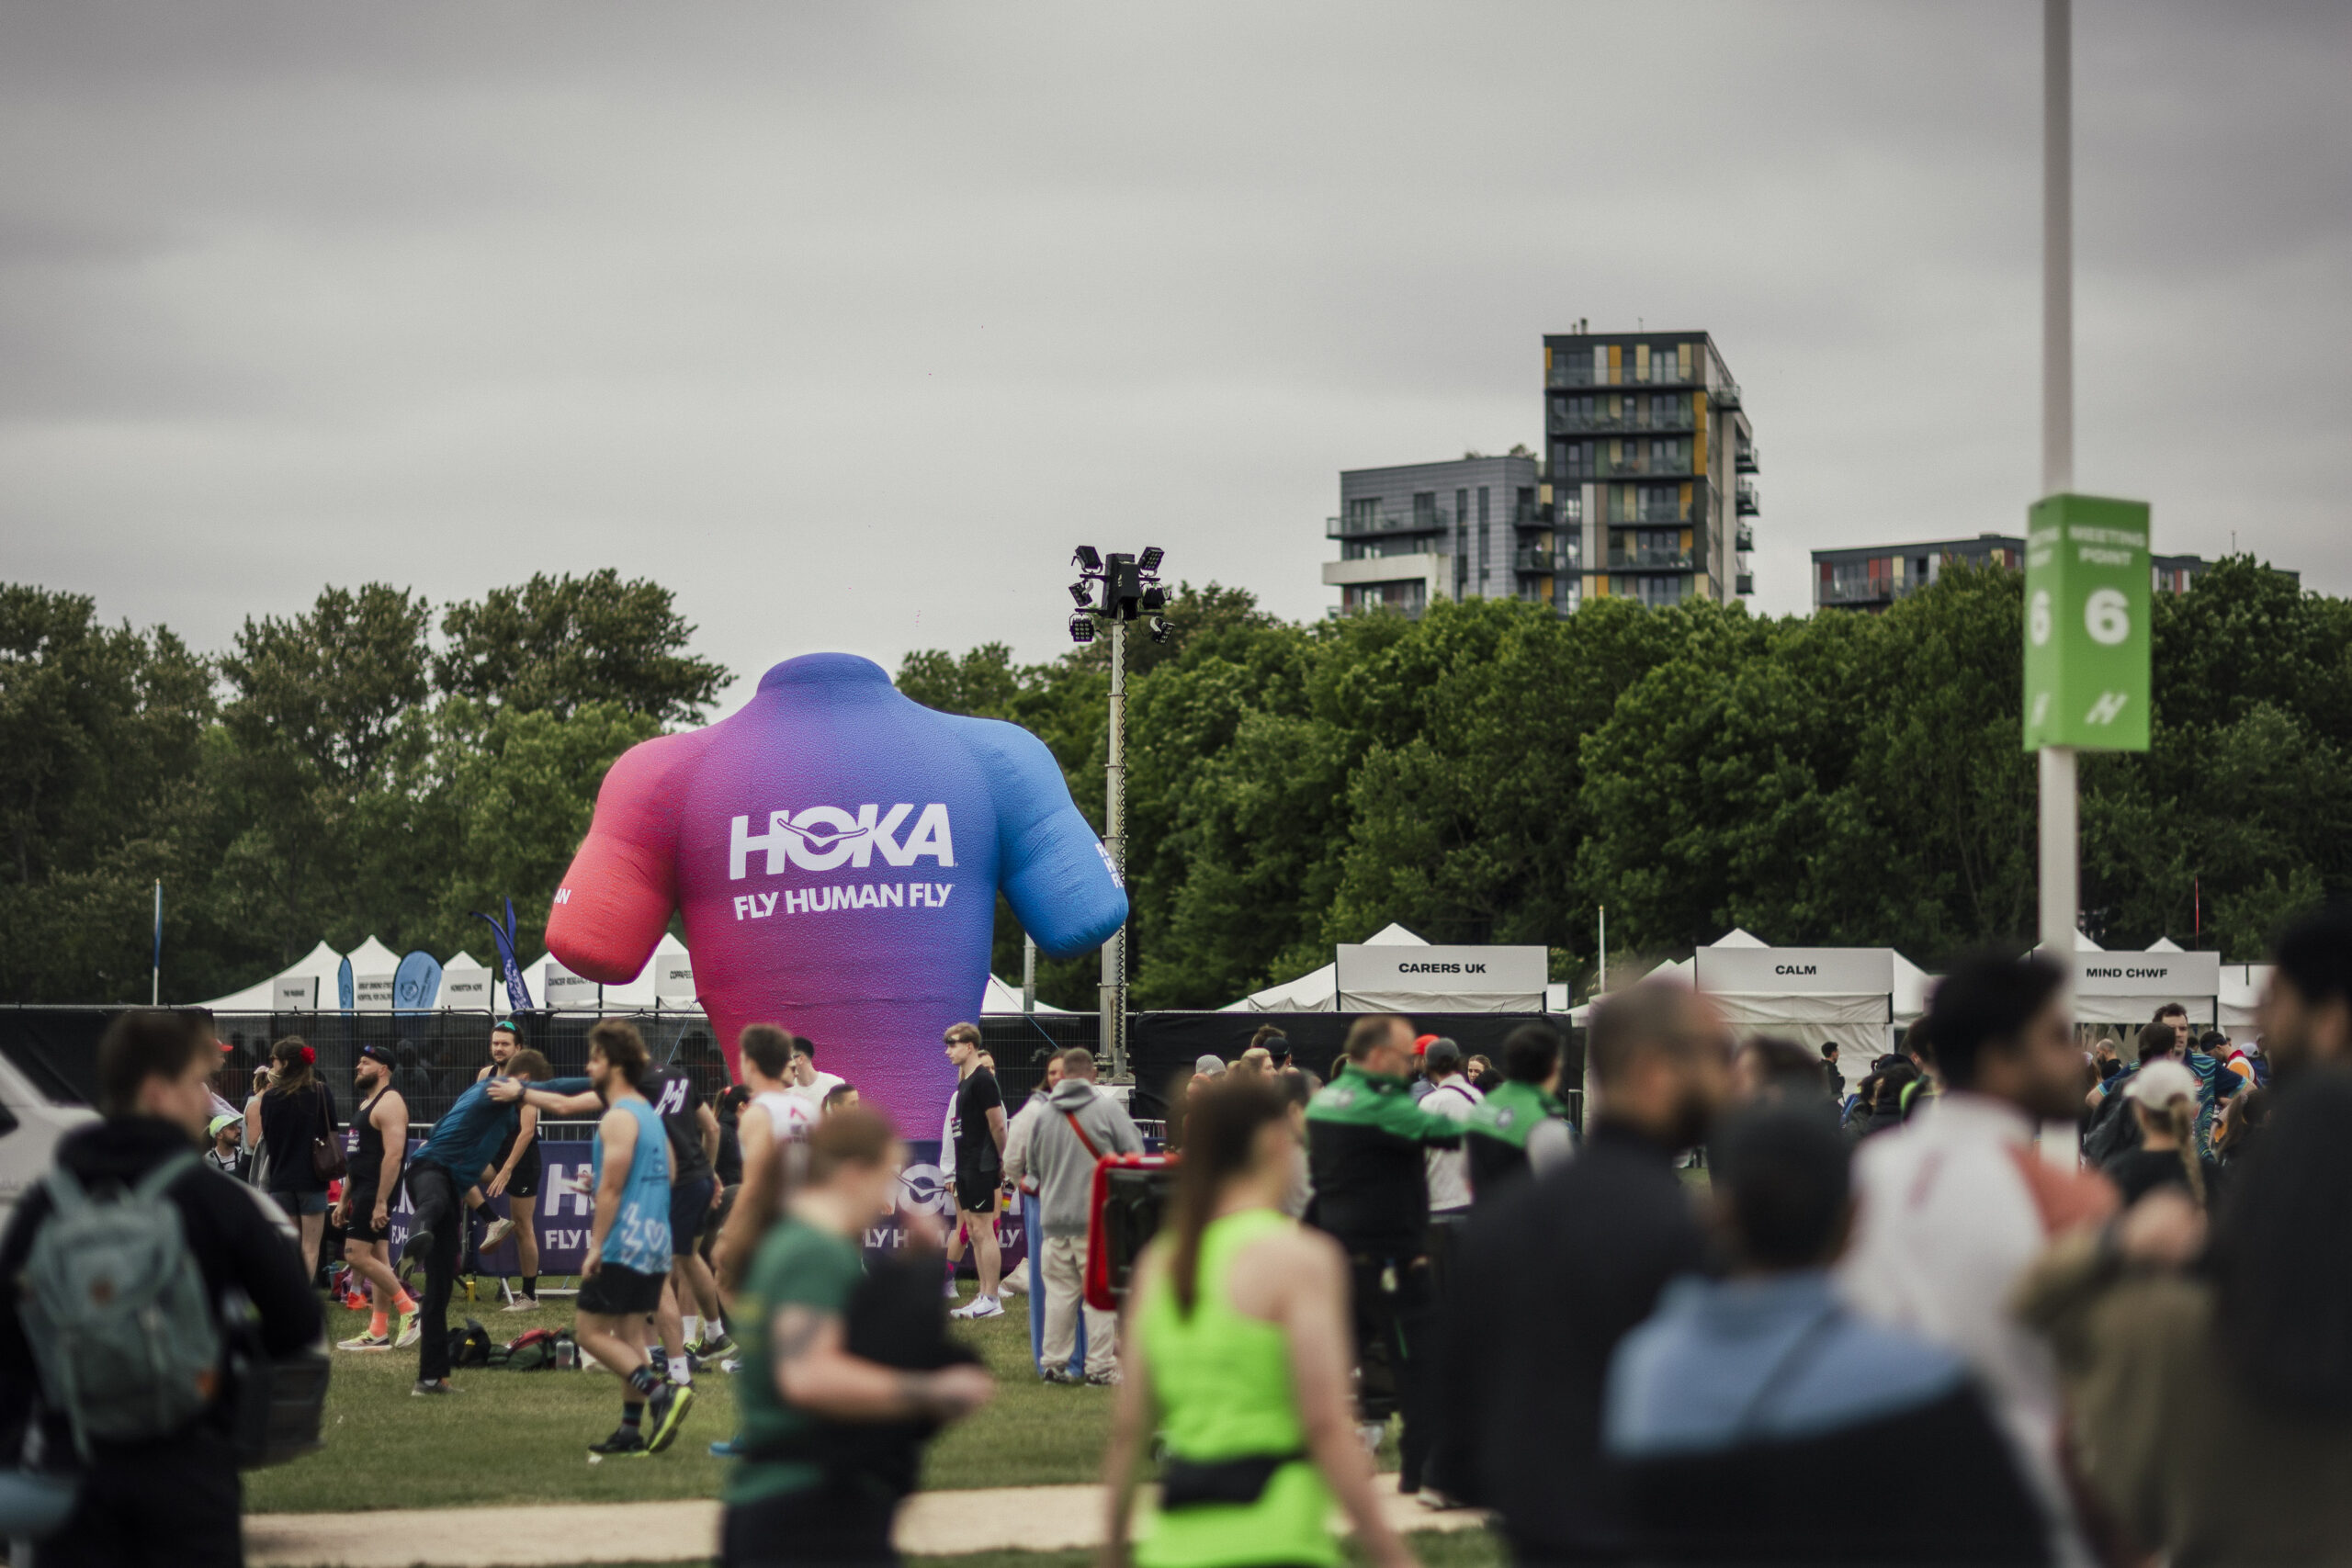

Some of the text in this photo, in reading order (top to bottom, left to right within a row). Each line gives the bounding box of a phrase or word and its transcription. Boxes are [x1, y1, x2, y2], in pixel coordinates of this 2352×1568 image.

[2084, 587, 2131, 646] 6
[730, 804, 955, 880] HOKA
[734, 883, 954, 920] FLY HUMAN FLY
[1398, 963, 1487, 974] CARERS UK
[1775, 964, 1816, 976] CALM
[2086, 968, 2168, 978] MIND CHWF
[545, 1229, 582, 1250] FLY
[998, 1228, 1021, 1249] LY
